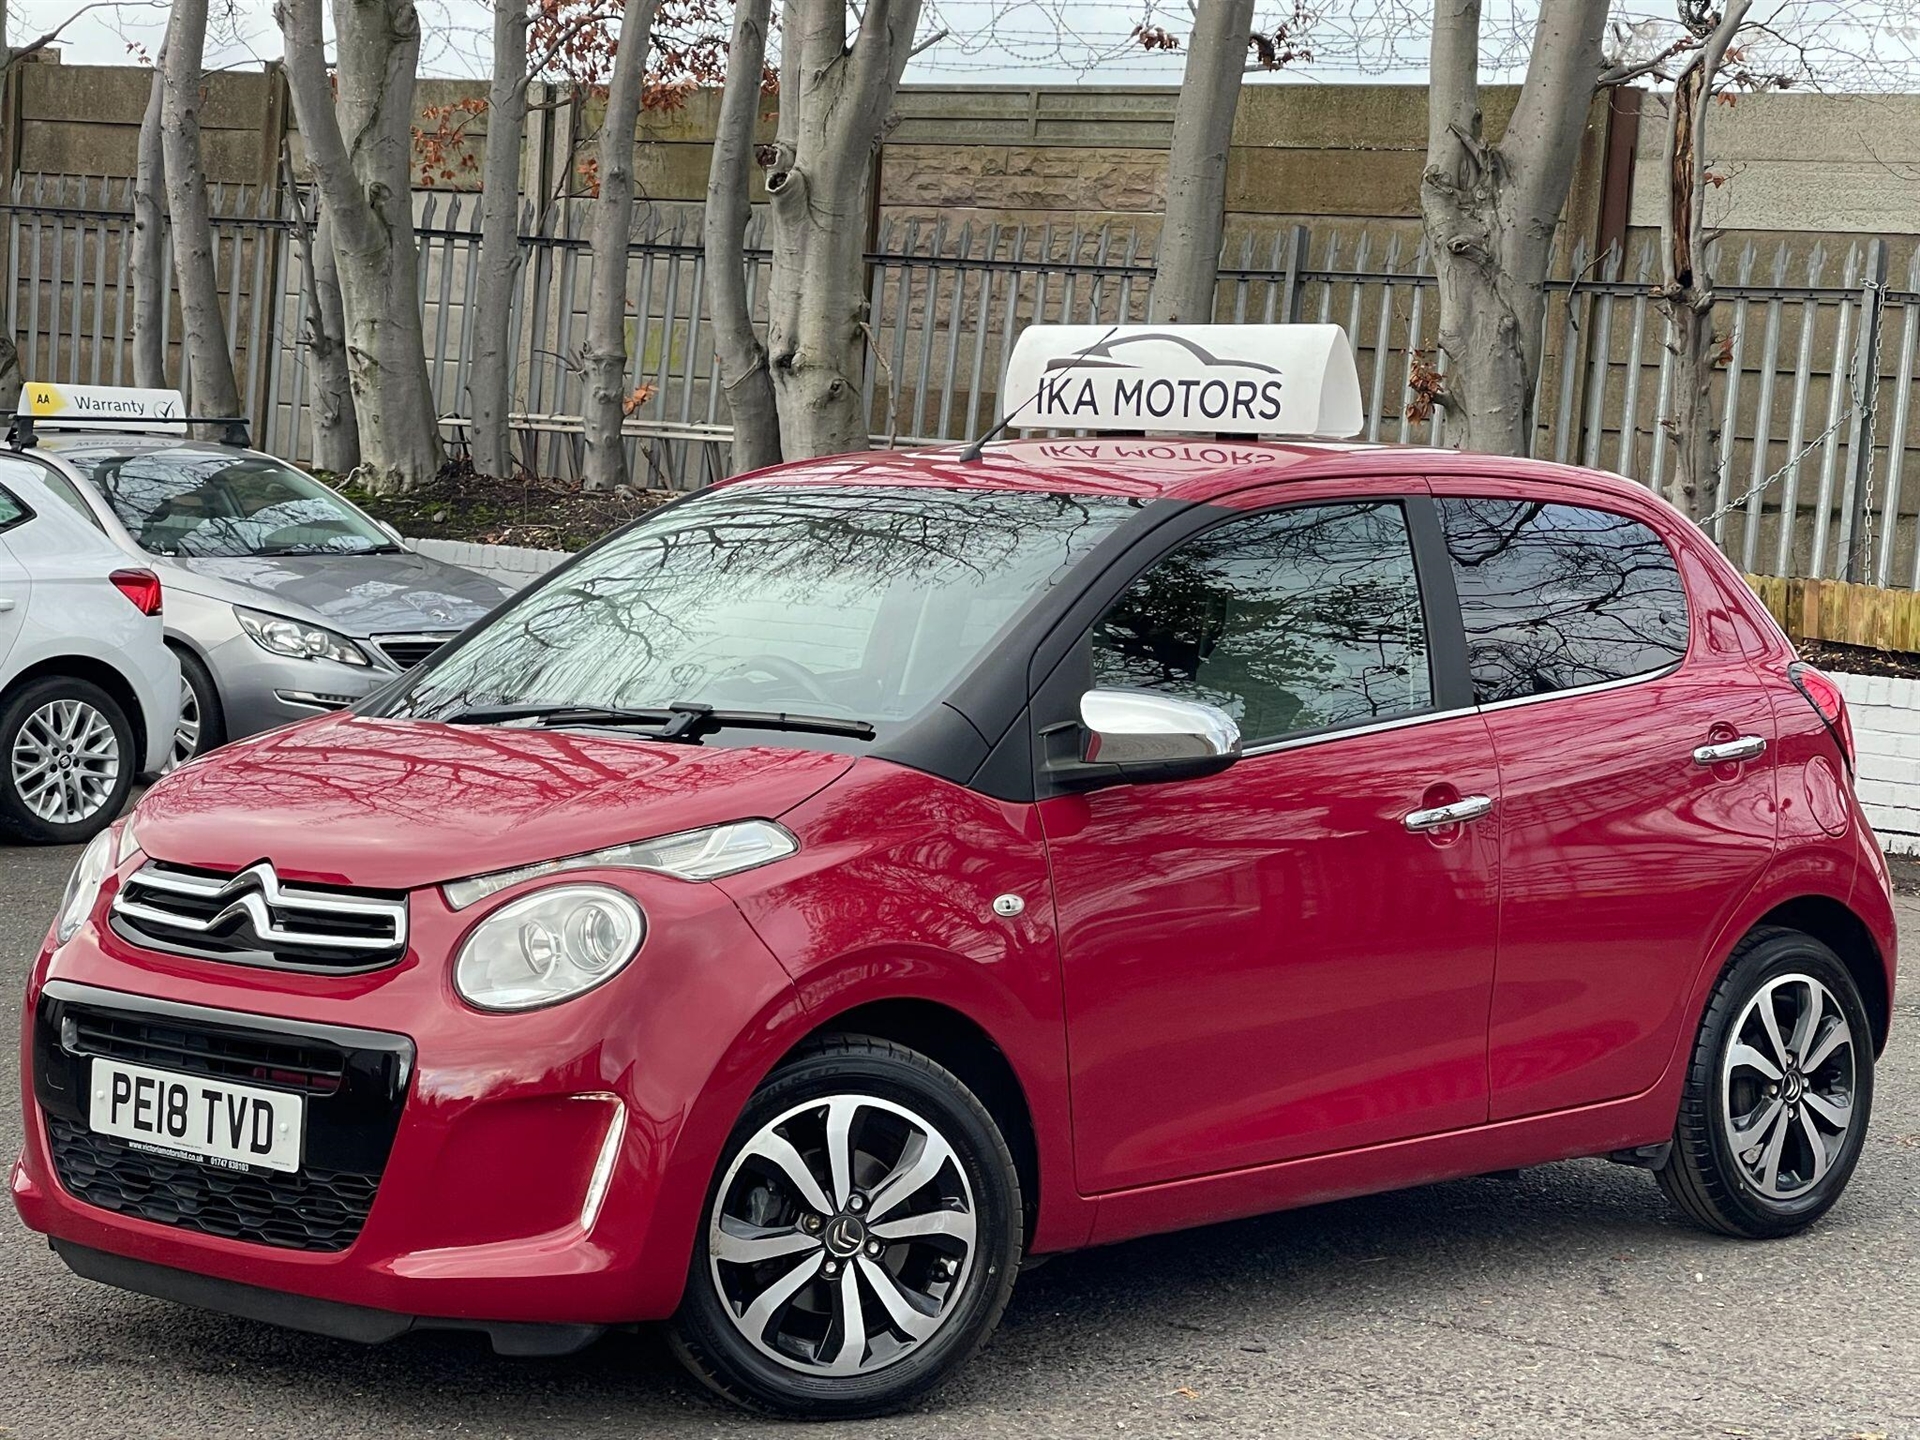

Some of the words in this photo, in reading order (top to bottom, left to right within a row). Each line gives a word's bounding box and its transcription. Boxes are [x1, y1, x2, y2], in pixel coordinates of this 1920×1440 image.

[36, 394, 50, 404] AA
[74, 396, 144, 415] Warranty
[1036, 377, 1099, 415] IKA
[1114, 379, 1283, 419] MOTORS
[111, 1072, 188, 1138] PE18
[202, 1089, 274, 1155] TVD
[210, 1156, 228, 1168] 01747
